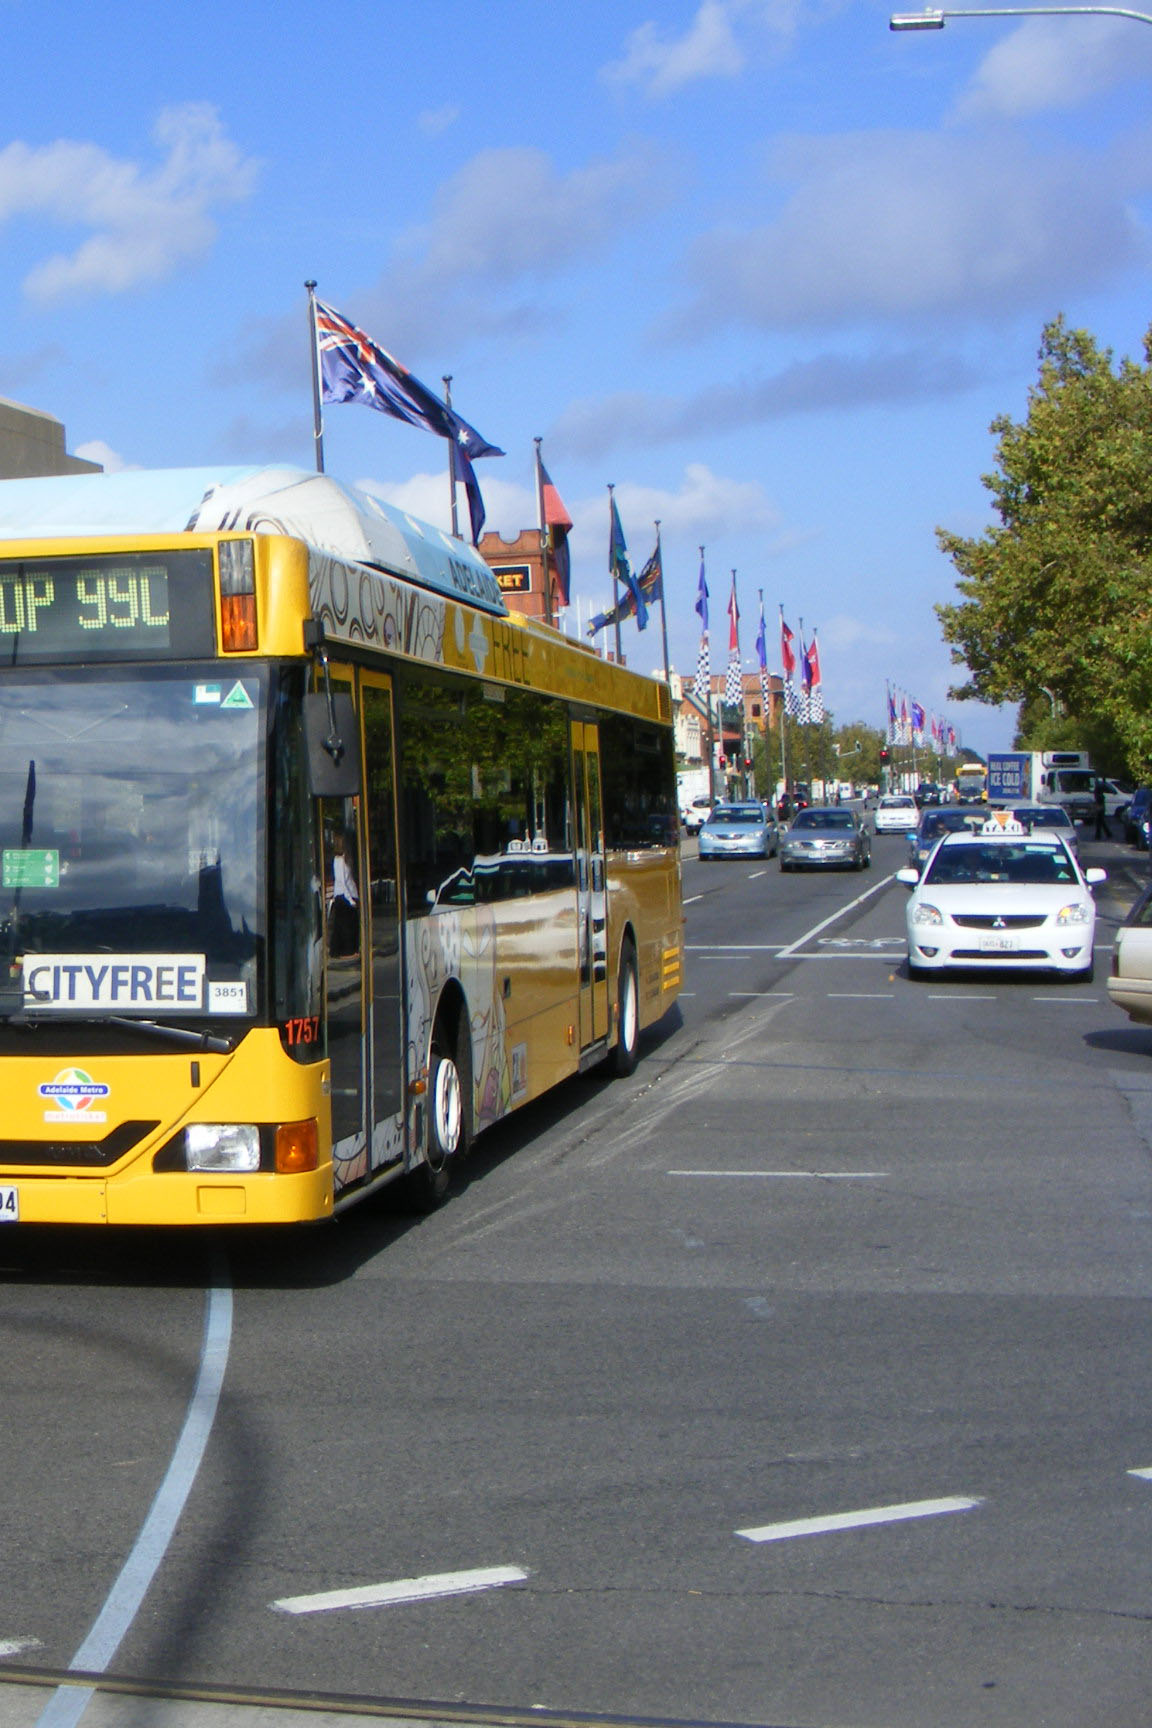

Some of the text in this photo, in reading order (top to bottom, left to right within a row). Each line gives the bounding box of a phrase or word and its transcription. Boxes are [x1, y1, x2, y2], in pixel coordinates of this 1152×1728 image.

[985, 822, 1019, 833] TAXI
[29, 964, 198, 1001] CITYFREE
[214, 986, 245, 998] 3851
[285, 1016, 319, 1046] 1757
[45, 1086, 104, 1094] Adelaide Metro
